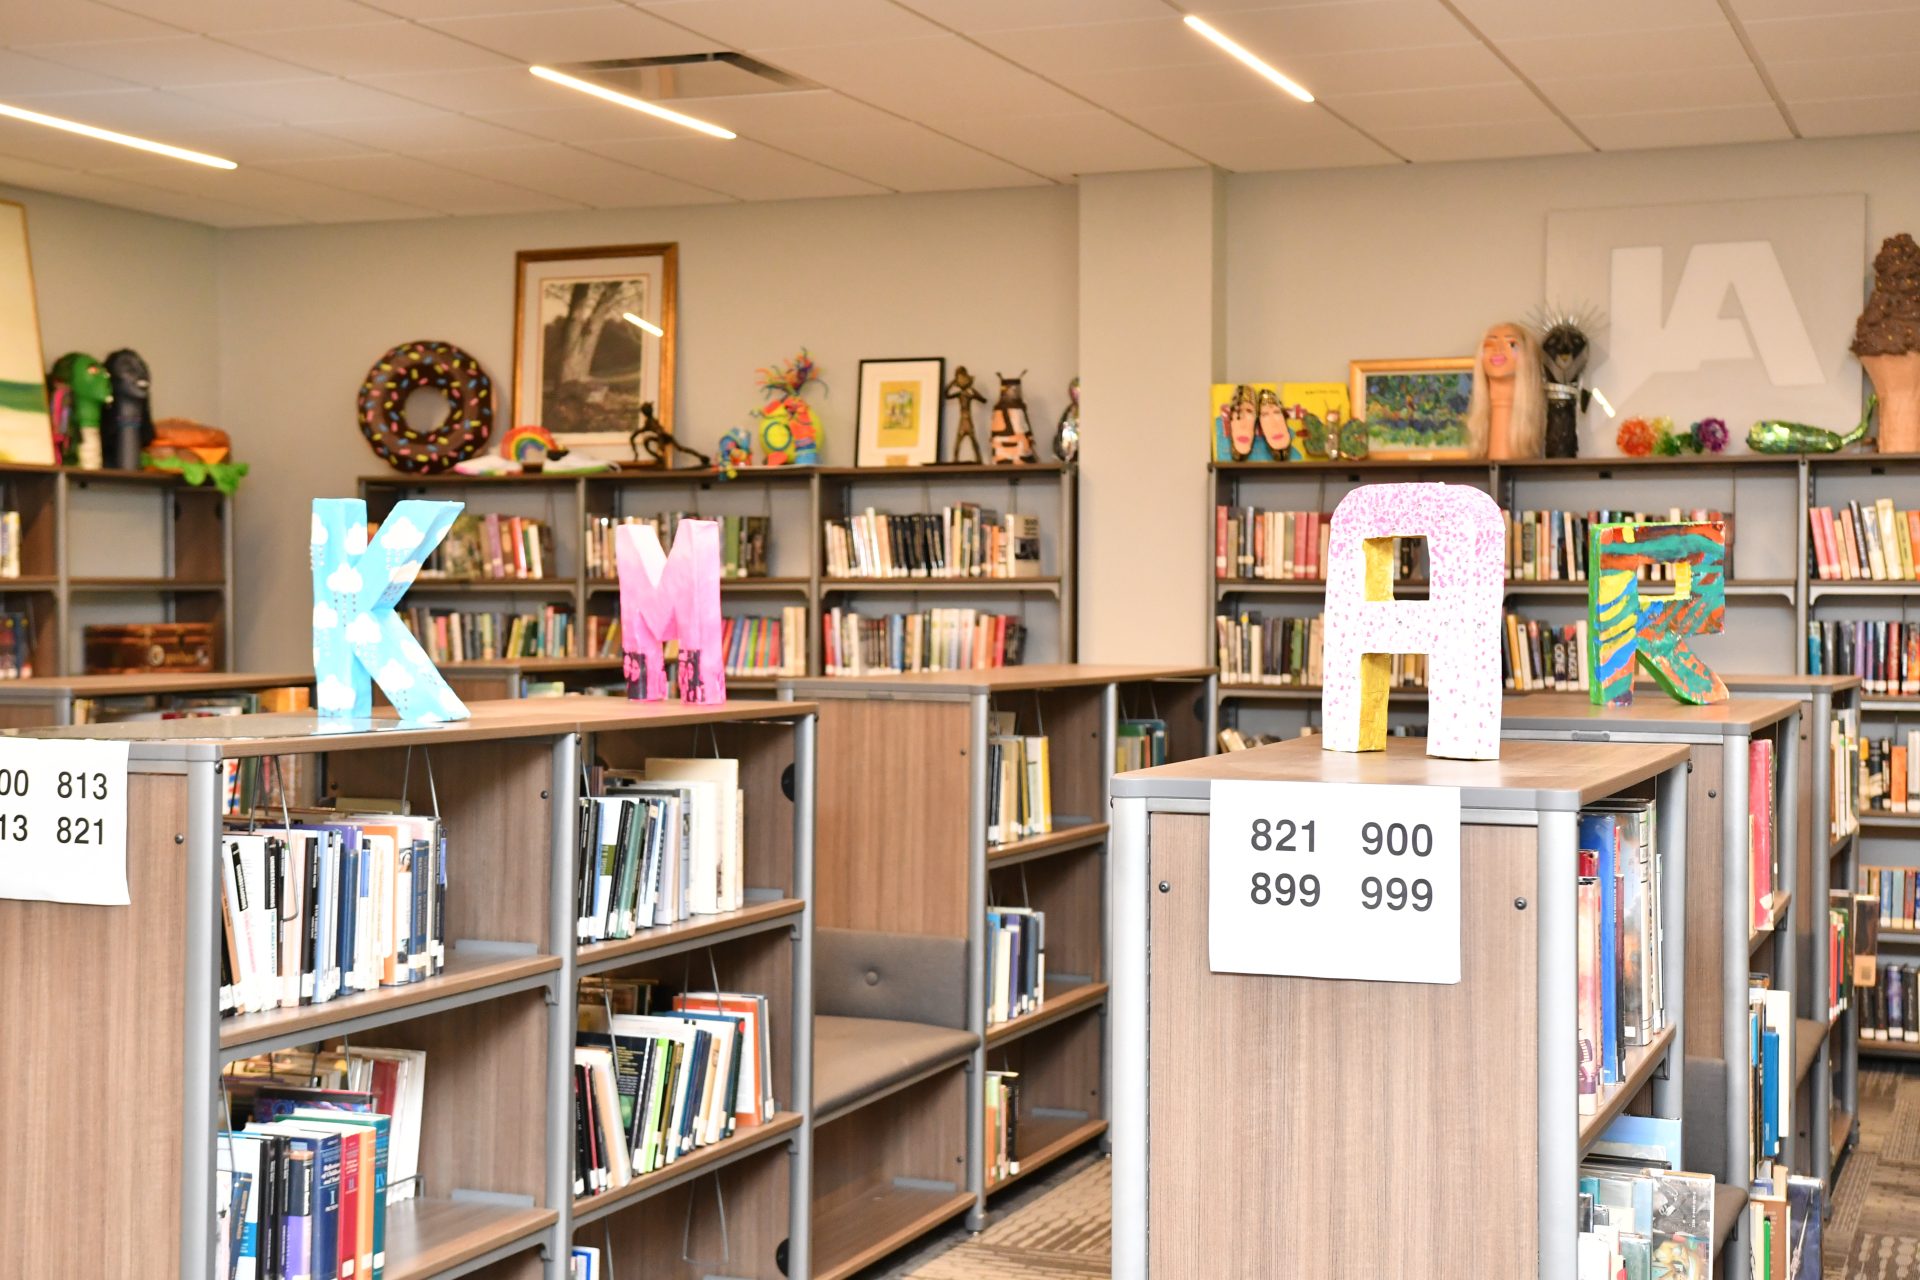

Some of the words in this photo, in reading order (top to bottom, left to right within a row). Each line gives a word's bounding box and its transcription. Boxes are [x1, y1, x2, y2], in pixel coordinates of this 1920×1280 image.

[310, 498, 471, 722] K
[615, 519, 727, 705] M
[1322, 482, 1506, 760] A
[1588, 521, 1730, 706] R
[0, 768, 29, 797] 00
[57, 772, 108, 801] 813
[0, 813, 28, 842] 13
[56, 816, 103, 845] 821
[1250, 818, 1316, 853] 821
[1361, 821, 1433, 858] 900
[1250, 871, 1321, 908] 899
[1361, 876, 1433, 912] 999
